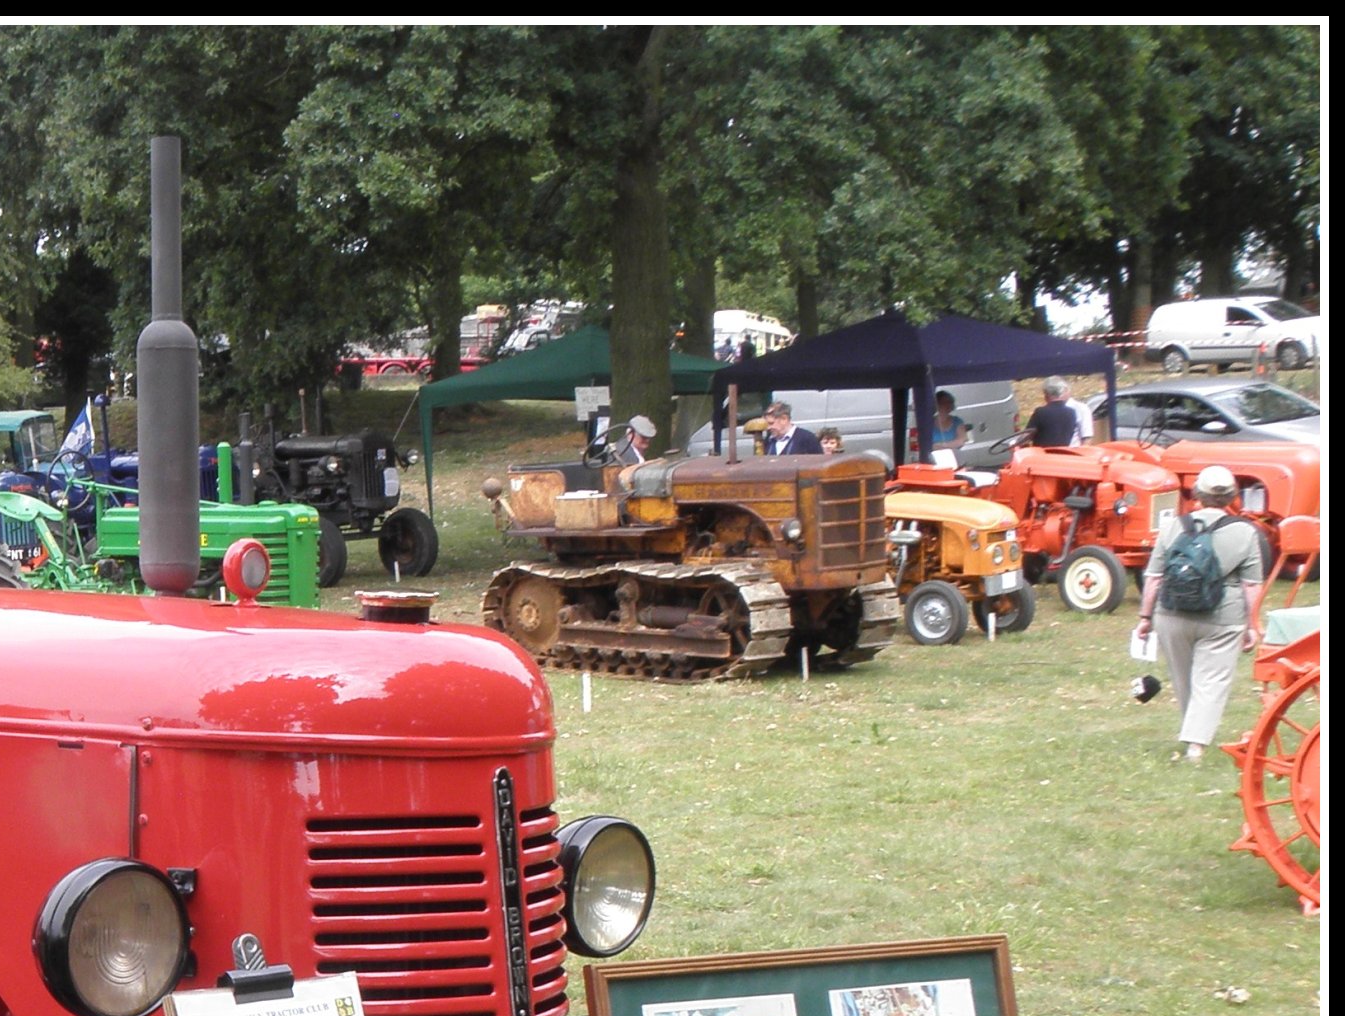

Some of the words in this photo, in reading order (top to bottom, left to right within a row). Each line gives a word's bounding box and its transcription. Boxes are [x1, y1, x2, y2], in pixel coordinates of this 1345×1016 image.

[498, 787, 518, 886] DAVID
[507, 906, 528, 1005] BROWN
[305, 1002, 329, 1013] CLUB
